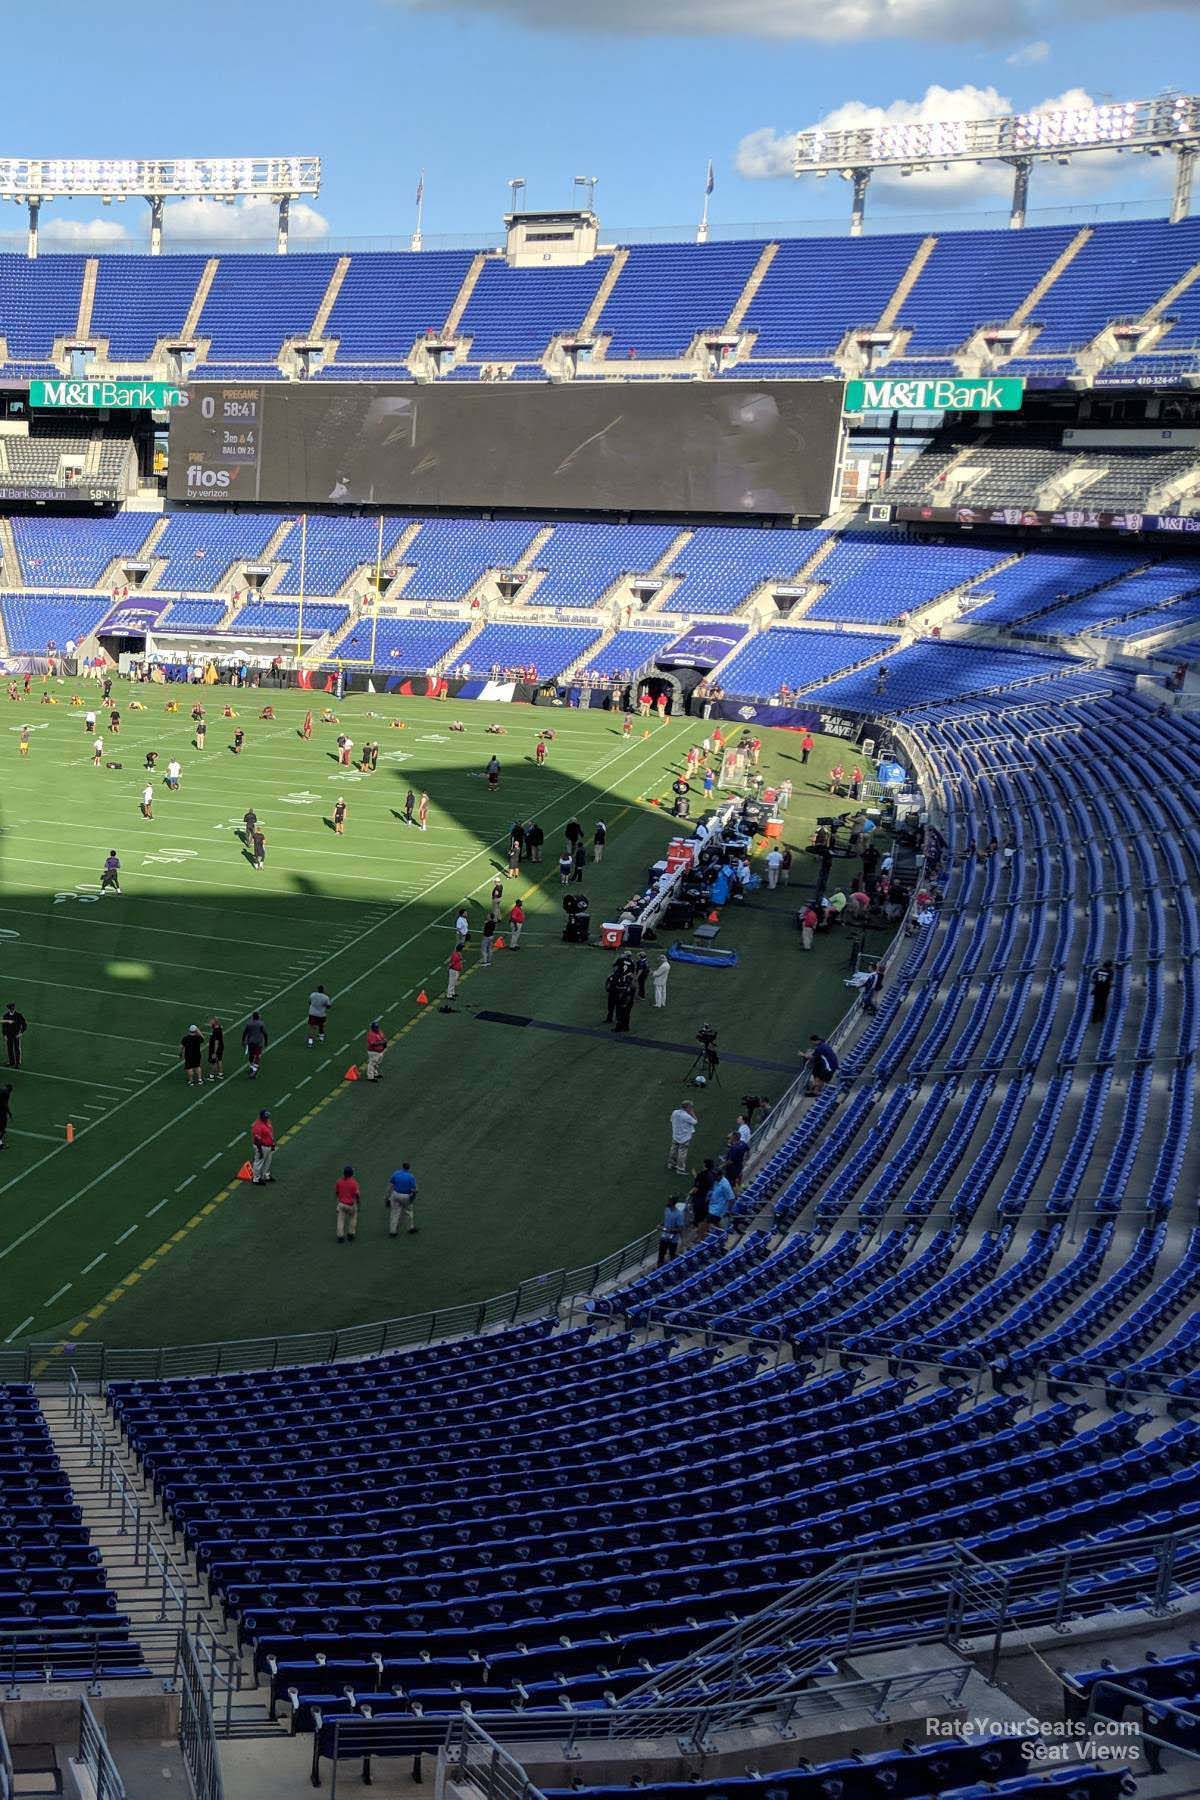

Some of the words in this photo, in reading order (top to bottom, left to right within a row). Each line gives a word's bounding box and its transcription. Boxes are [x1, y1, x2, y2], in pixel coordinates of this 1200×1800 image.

[43, 382, 100, 407] M&T
[101, 382, 156, 407] Bank
[223, 389, 259, 400] PREGAME
[862, 381, 934, 408] M&T
[934, 381, 1003, 408] Bank
[201, 397, 215, 419] 0
[223, 402, 256, 417] 58:41
[223, 431, 238, 443] 3RD
[246, 432, 254, 443] 4
[186, 465, 231, 487] fios
[8, 488, 29, 498] Bank
[30, 488, 66, 499] Stadium
[187, 488, 197, 498] by
[199, 488, 229, 497] verizon
[1157, 516, 1185, 530] M&T
[820, 714, 841, 726] PLAY
[606, 932, 617, 942] G
